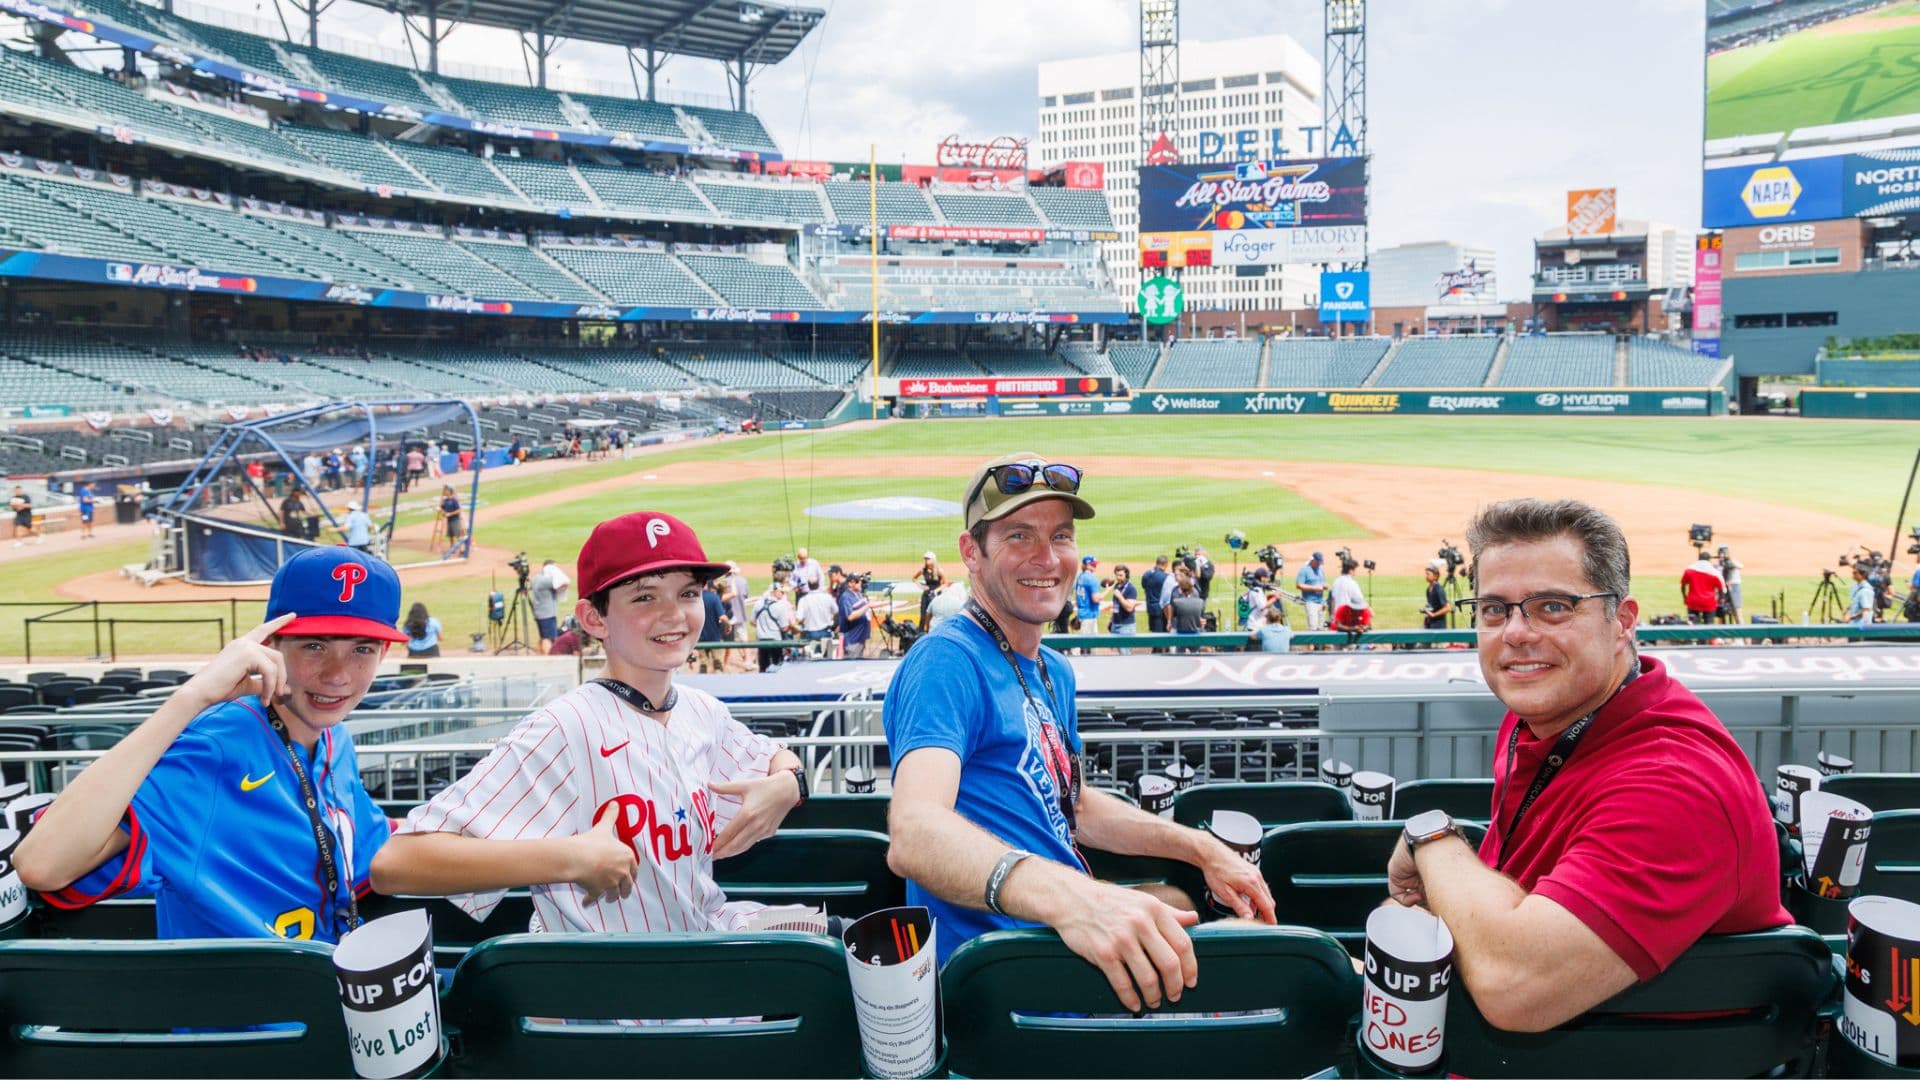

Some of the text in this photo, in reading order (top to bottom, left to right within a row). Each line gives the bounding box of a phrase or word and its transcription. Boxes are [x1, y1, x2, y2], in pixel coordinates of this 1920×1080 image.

[1199, 122, 1357, 159] DELTA
[1176, 177, 1330, 207] All Star Game
[1752, 182, 1792, 203] NAPA
[1292, 227, 1361, 244] EMORY
[1759, 226, 1815, 244] ORIS
[1224, 233, 1276, 261] Kroger
[894, 268, 1076, 286] HANK AARON TERRACE
[1323, 301, 1366, 311] FANDUEL
[928, 381, 988, 394] Budweiser
[1171, 398, 1220, 410] Wellstar
[1245, 393, 1306, 413] xfinity
[1328, 393, 1400, 407] QUIKRETE
[1428, 396, 1502, 410] EQUIFAX
[1562, 394, 1629, 406] HYUNDAI
[645, 518, 671, 549] P
[331, 562, 368, 603] P
[1363, 791, 1386, 803] FOR
[1843, 828, 1850, 840] I
[347, 950, 433, 1005] UP FOR
[1384, 964, 1452, 994] UP FO
[388, 1010, 432, 1055] Lost
[1367, 1020, 1442, 1054] ONES
